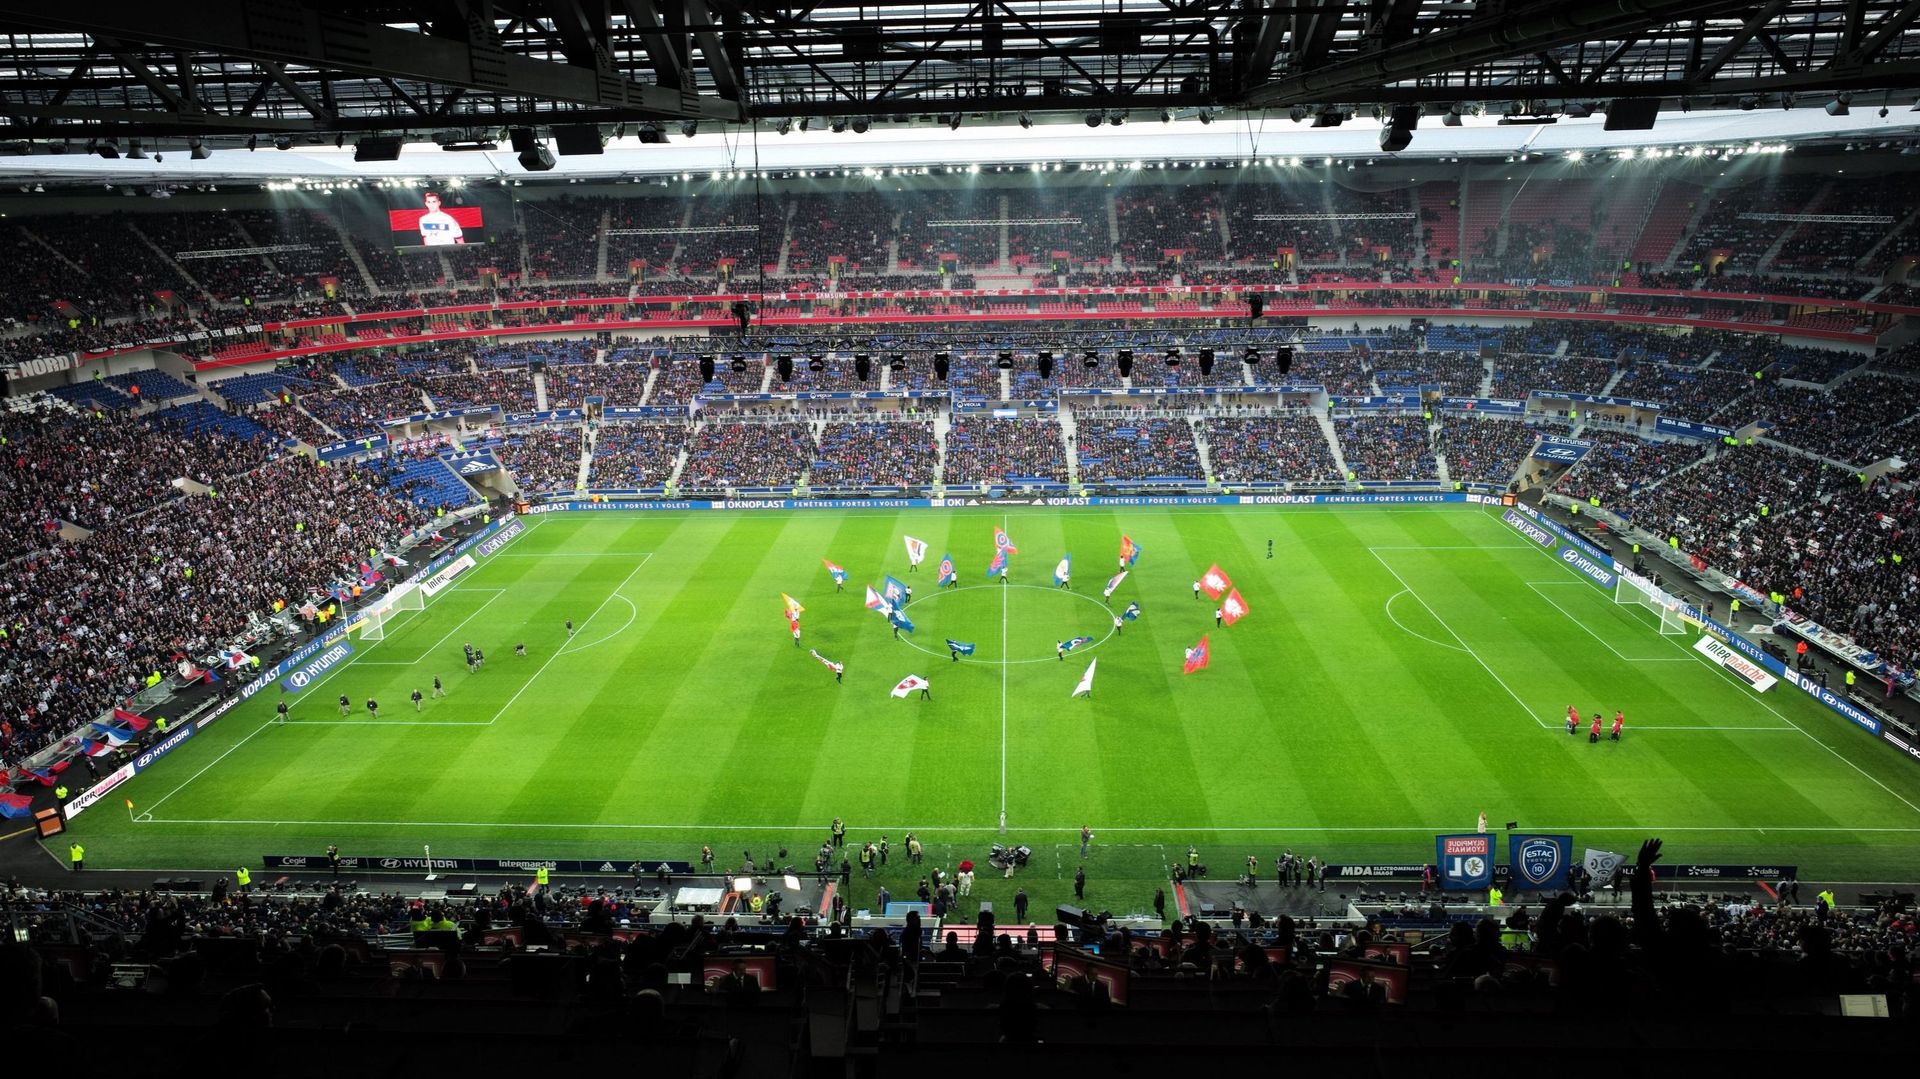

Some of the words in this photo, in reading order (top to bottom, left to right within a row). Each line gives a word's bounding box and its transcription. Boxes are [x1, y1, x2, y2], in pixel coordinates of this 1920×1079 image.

[210, 329, 222, 338] EST
[224, 327, 242, 335] AVEC
[245, 324, 262, 333] VOUS
[19, 355, 70, 378] NORD
[1631, 400, 1644, 408] MDA
[1646, 402, 1660, 410] MDA
[1661, 418, 1676, 426] MDA
[1677, 421, 1691, 429] MDA
[1702, 426, 1716, 434] MDA
[1718, 429, 1731, 437] MDA
[1561, 437, 1591, 446] HYUNDAI
[727, 500, 786, 509] OKNOPLAST
[1256, 495, 1316, 504] OKNOPLAST
[500, 524, 521, 542] SPORTS
[1524, 523, 1547, 543] SPORTS
[1575, 558, 1612, 584] HYUNDAI
[308, 645, 348, 677] HYUNDAI
[1706, 640, 1766, 682] Intermarché
[1736, 639, 1764, 661] VOLETS
[1801, 678, 1820, 698] OKI
[216, 696, 239, 716] adidas
[1837, 702, 1876, 730] HYUNDAI
[154, 728, 190, 756] HYUNDAI
[282, 857, 306, 865] Cegid
[1526, 849, 1553, 858] ESTAC
[404, 859, 458, 869] HYUNDAI
[1340, 866, 1373, 876] MDA
